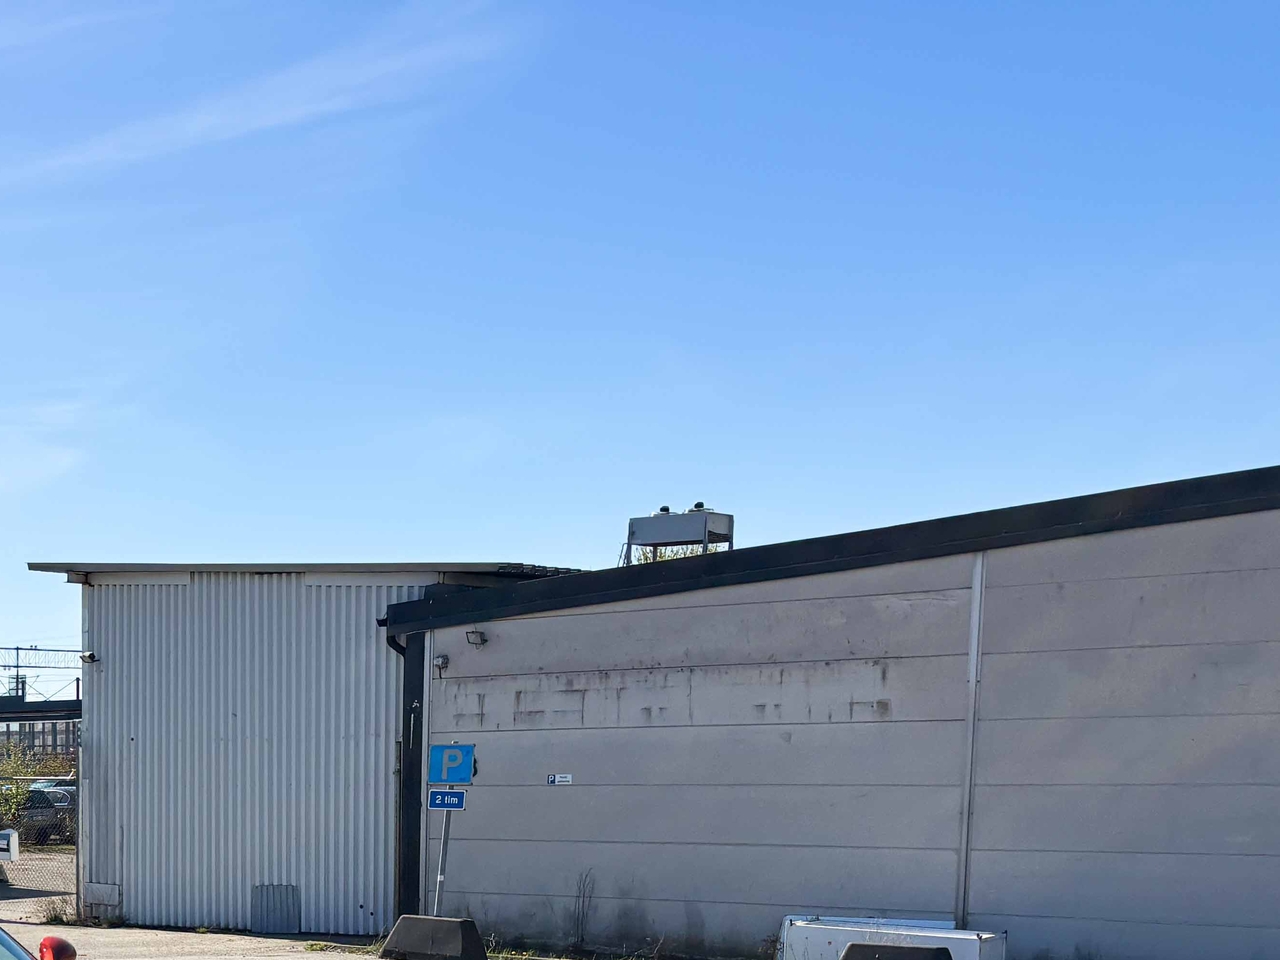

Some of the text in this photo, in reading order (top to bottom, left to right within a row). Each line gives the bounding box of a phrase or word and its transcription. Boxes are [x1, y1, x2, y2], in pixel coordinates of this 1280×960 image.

[442, 749, 463, 780] P
[435, 795, 458, 804] 2 tim
